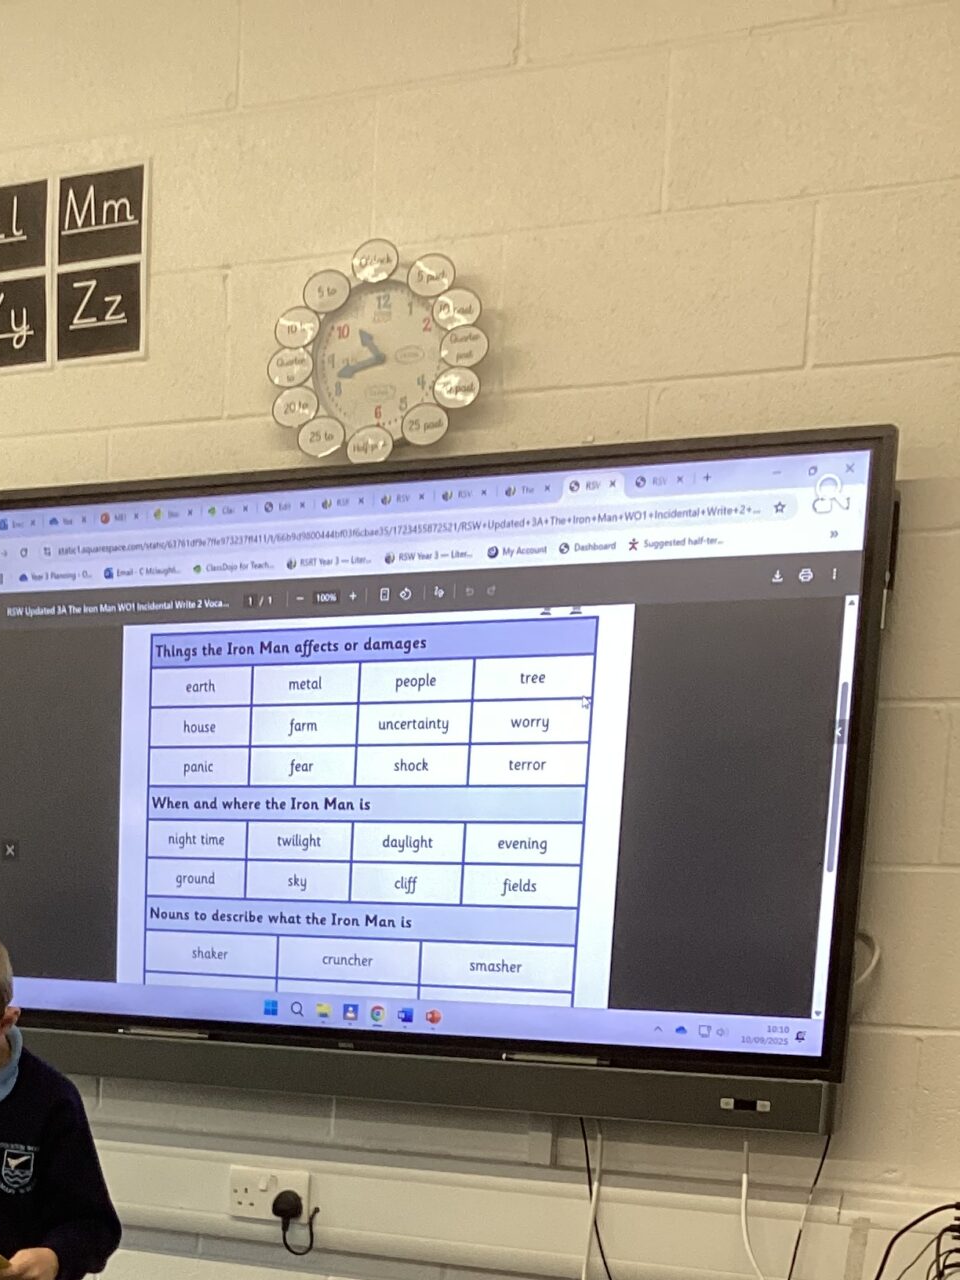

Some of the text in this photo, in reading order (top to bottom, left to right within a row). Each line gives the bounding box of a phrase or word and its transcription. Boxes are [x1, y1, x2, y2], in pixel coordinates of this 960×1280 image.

[62, 186, 138, 235] Mm
[317, 286, 337, 298] 5 to
[69, 280, 127, 329] Zz
[376, 294, 392, 309] 12
[408, 301, 414, 316] 1
[337, 324, 350, 339] 10
[422, 318, 432, 333] 2
[449, 332, 482, 345] Quarter
[276, 356, 307, 368] Quarter
[328, 355, 336, 368] 9
[335, 382, 342, 396] 8
[417, 373, 426, 390] 4
[283, 401, 296, 413] 20
[399, 395, 407, 411] 5
[374, 404, 382, 419] 6
[408, 417, 443, 431] 25 past
[309, 430, 334, 442] 25 to
[574, 541, 617, 552] Dashboard
[643, 537, 686, 549] Suggested
[316, 592, 337, 603] 100%
[25, 606, 56, 617] Updated
[69, 605, 81, 615] The
[100, 603, 116, 613] Man
[137, 601, 173, 612] Incidental
[175, 599, 196, 610] Write
[155, 637, 427, 661] Things the Iron Man affects or damages
[186, 672, 546, 693] earth metal people tree
[183, 717, 549, 736] house farm uncertainty worry
[183, 758, 547, 776] panic fear shock terror
[152, 796, 371, 810] When and where the Iron Man is
[168, 833, 548, 854] night time twilight daylight evening
[176, 872, 537, 896] ground sky cliff fields
[150, 907, 412, 928] Nouns to describe what the Iron Man is
[192, 949, 523, 973] shaker cruncher smasher
[767, 1025, 790, 1034] 10:10
